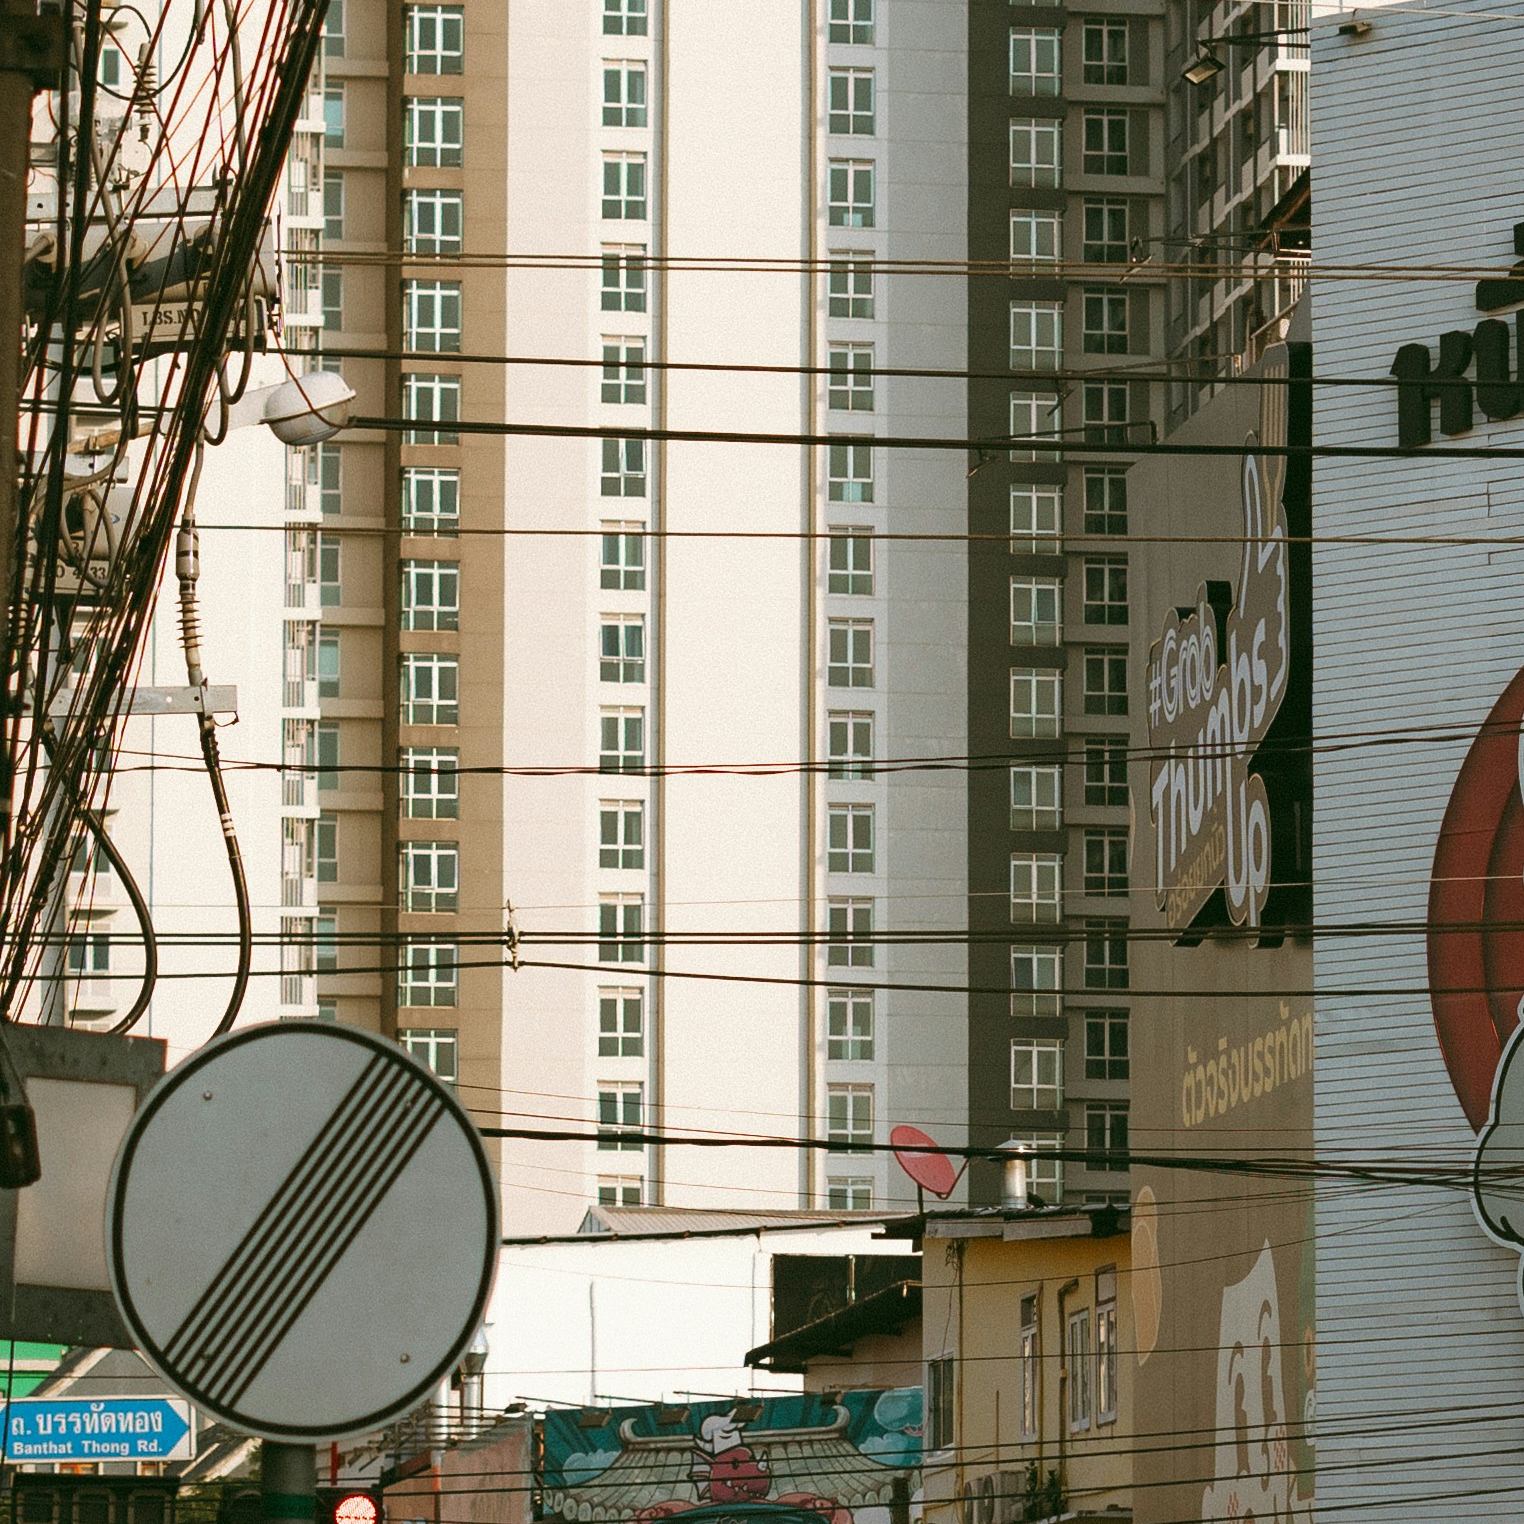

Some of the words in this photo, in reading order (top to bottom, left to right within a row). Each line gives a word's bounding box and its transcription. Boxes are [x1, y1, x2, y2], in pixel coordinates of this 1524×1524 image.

[1152, 618, 1267, 894] Thumbs
[1226, 763, 1268, 930] Up
[11, 1417, 32, 1436] ถ.
[36, 1402, 163, 1435] บรรทัดทอง
[13, 1441, 72, 1455] Banthat
[81, 1440, 130, 1456] Thong
[137, 1439, 163, 1453] Rd.
